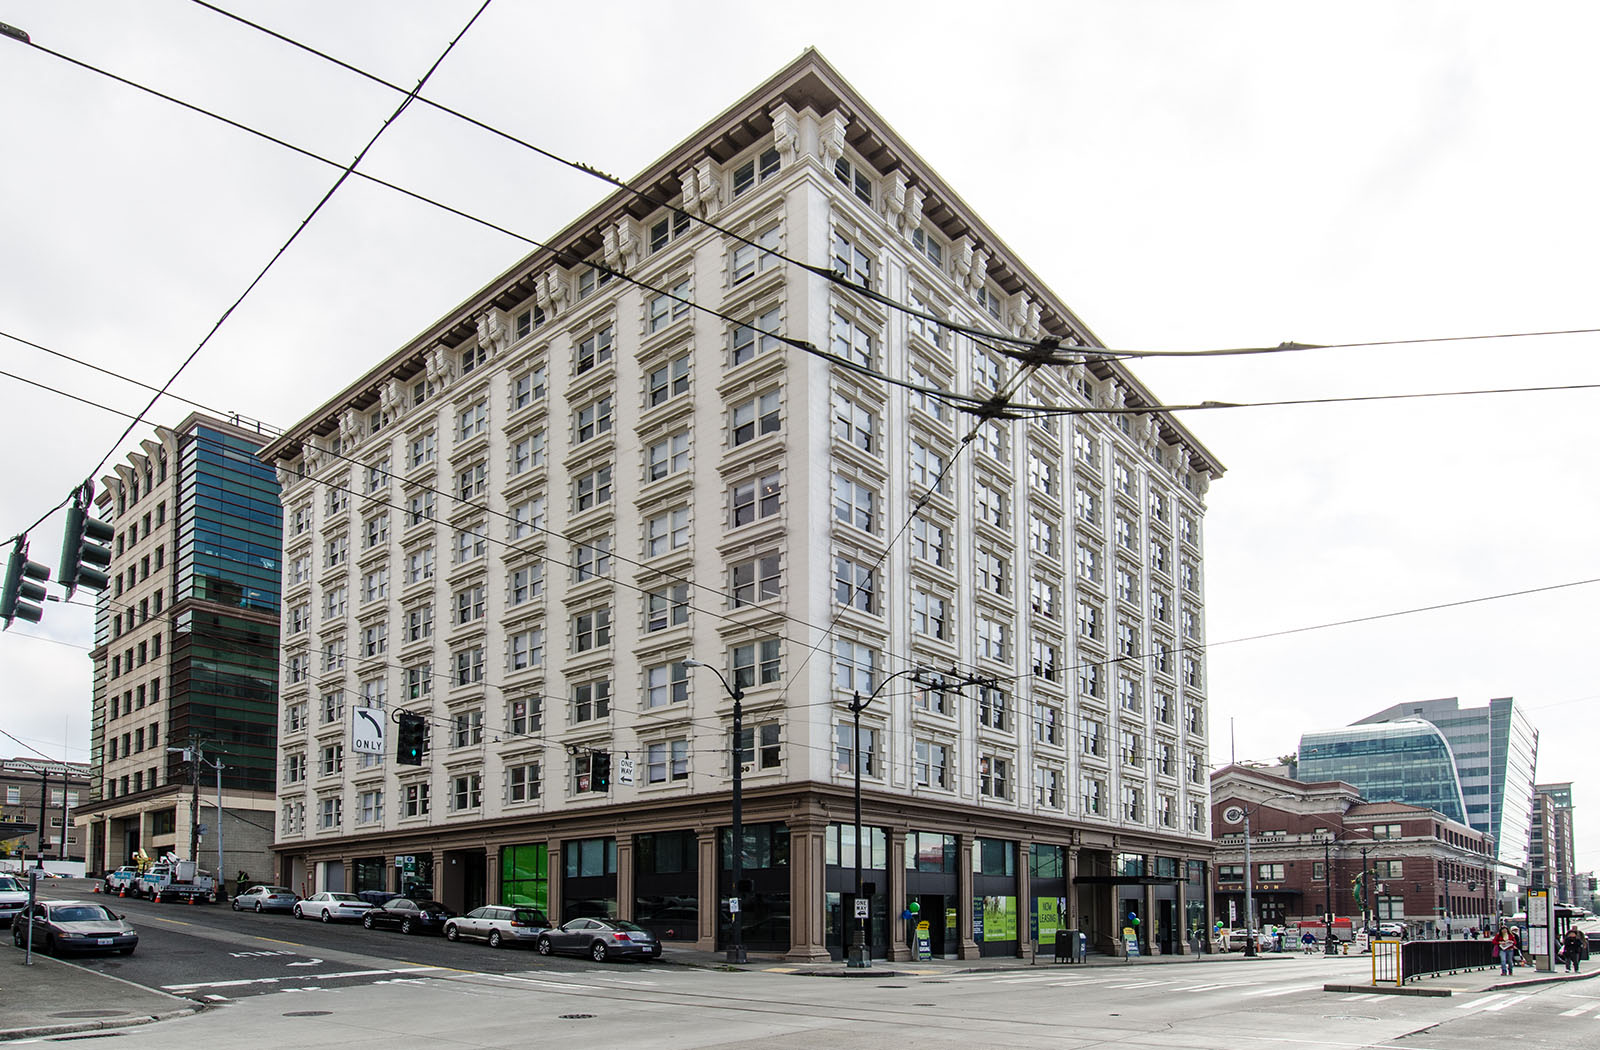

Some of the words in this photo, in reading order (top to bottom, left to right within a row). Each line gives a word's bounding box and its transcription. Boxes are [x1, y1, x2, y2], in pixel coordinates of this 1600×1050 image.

[356, 740, 381, 750] ONLY
[620, 760, 633, 768] ONE
[1039, 913, 1057, 923] LEASING
